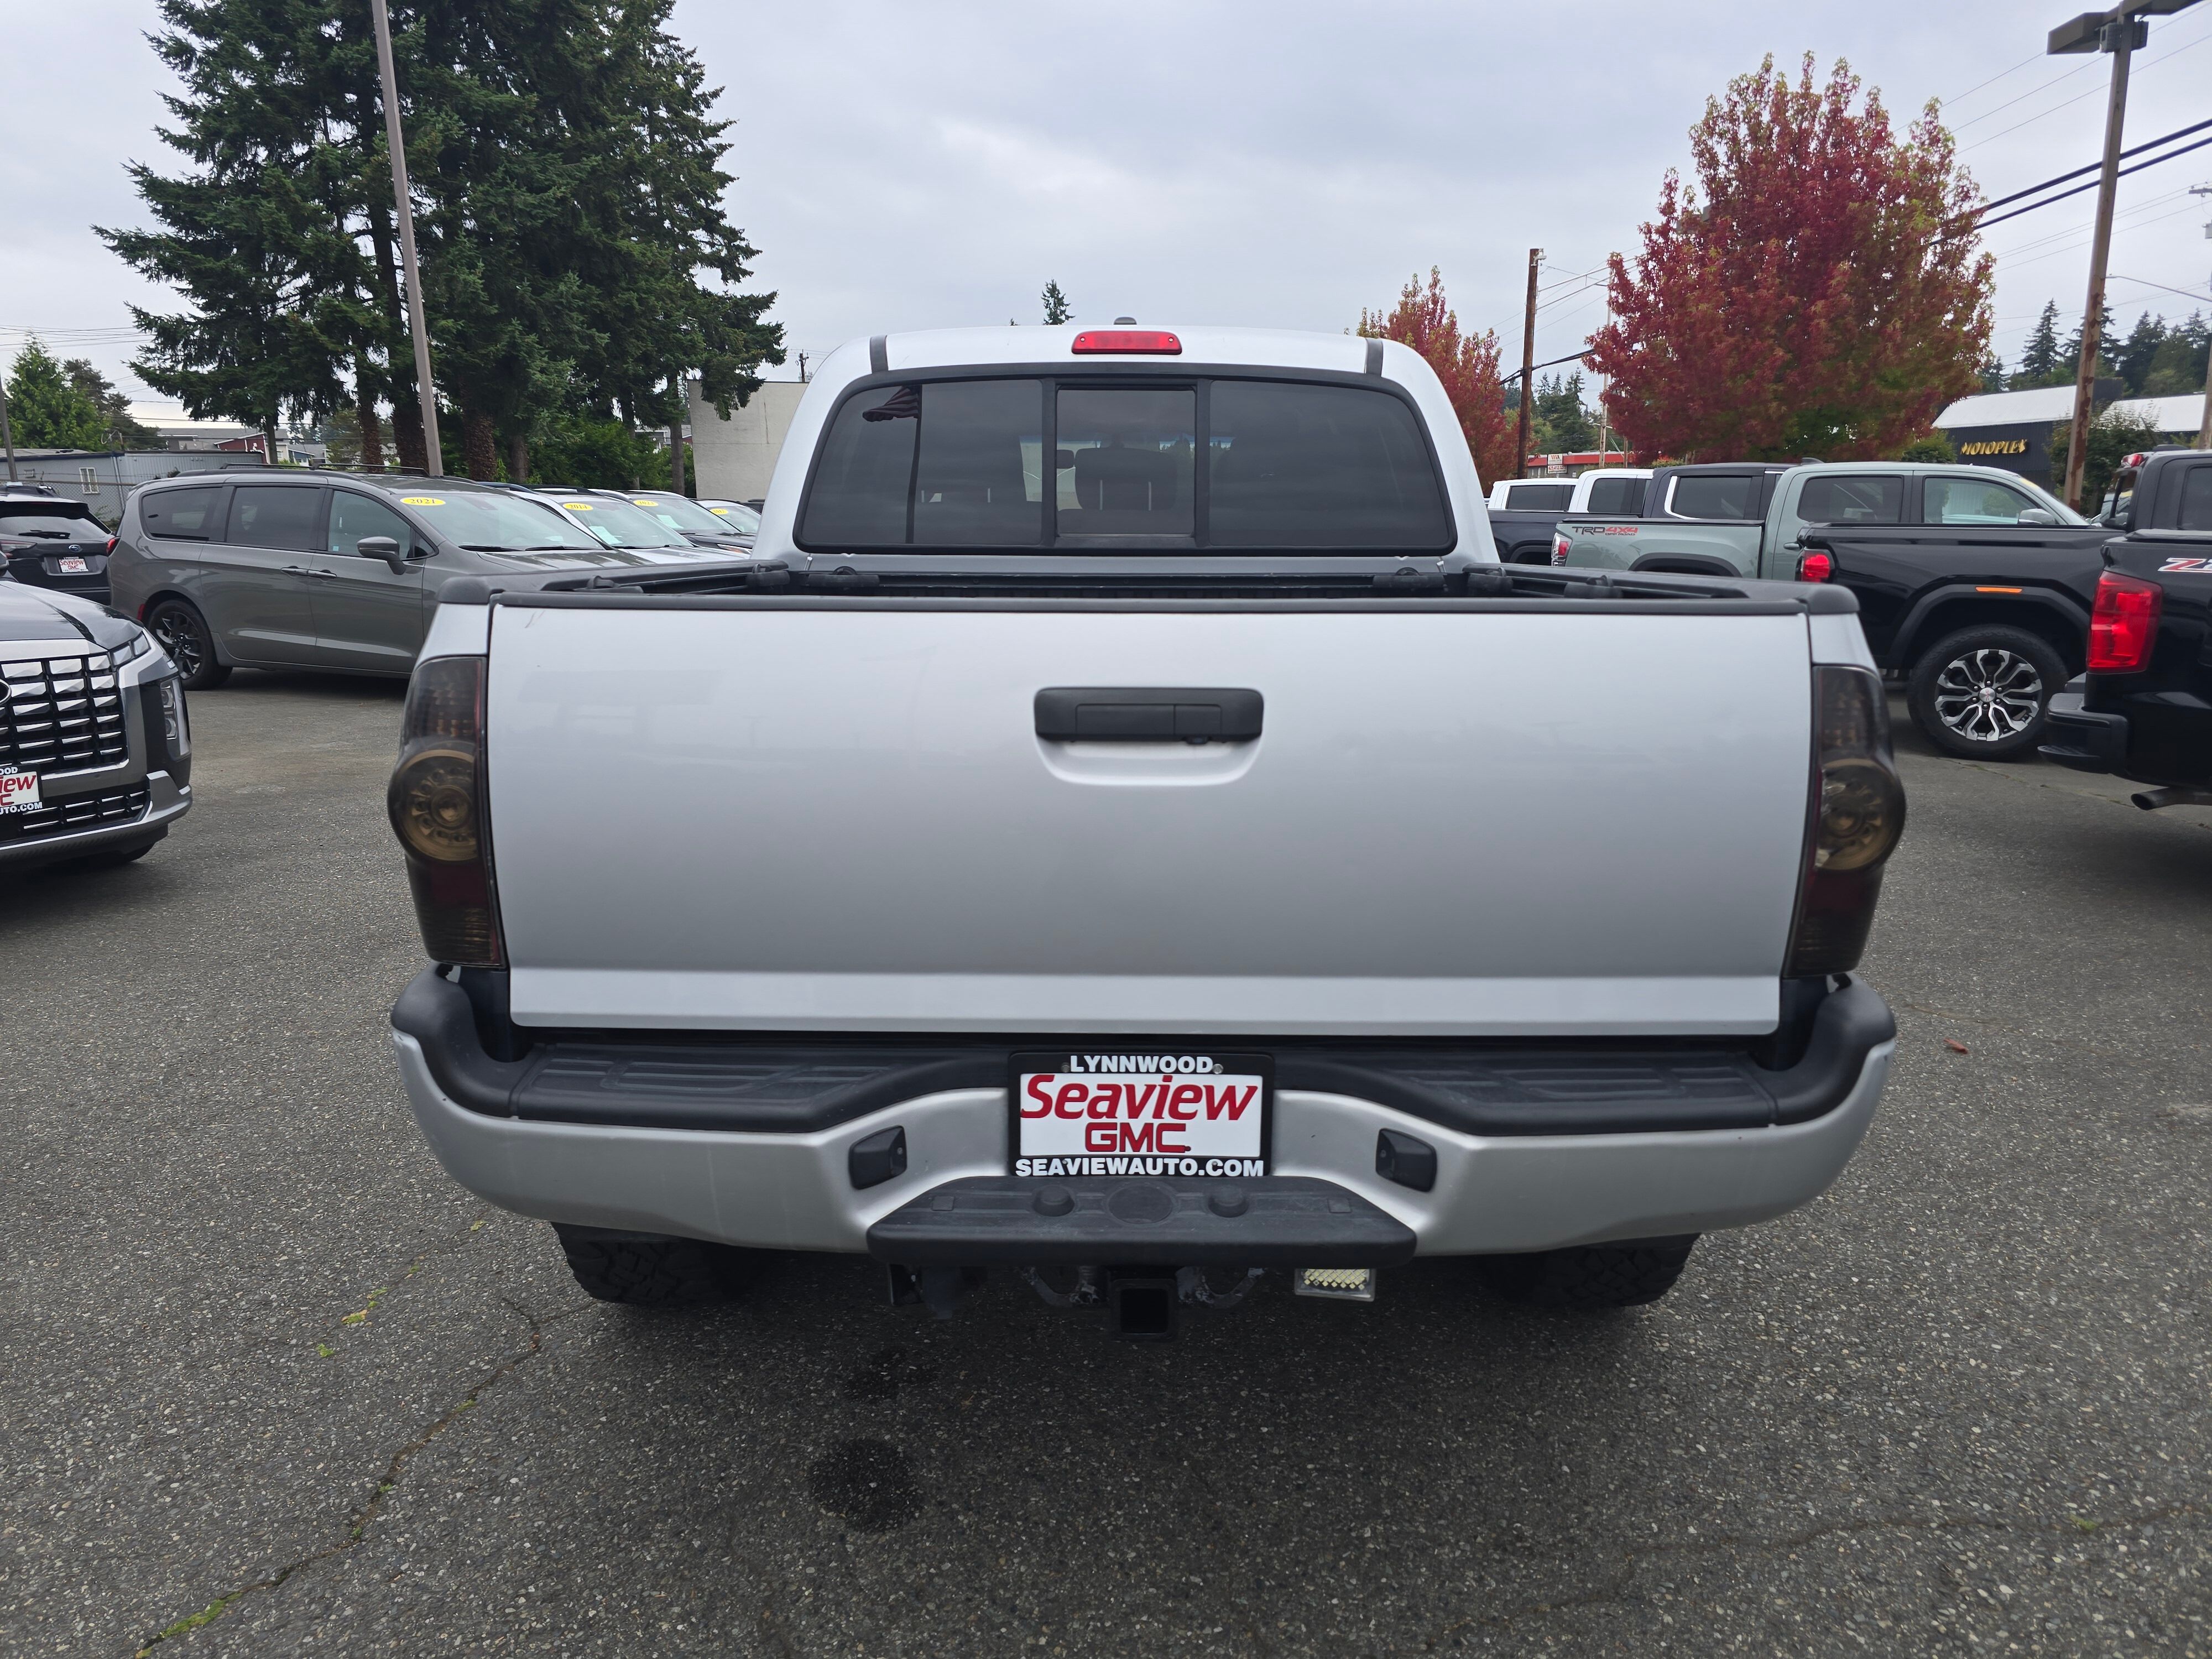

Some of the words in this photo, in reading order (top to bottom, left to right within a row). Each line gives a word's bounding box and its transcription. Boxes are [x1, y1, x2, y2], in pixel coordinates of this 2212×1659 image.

[1572, 526, 1605, 535] TRD
[1070, 1055, 1214, 1073] LYNNWOOD
[1020, 1074, 1259, 1120] Seaview
[1084, 1122, 1191, 1154] GMC
[1015, 1157, 1264, 1177] SEAVIEWAUTO.COM
